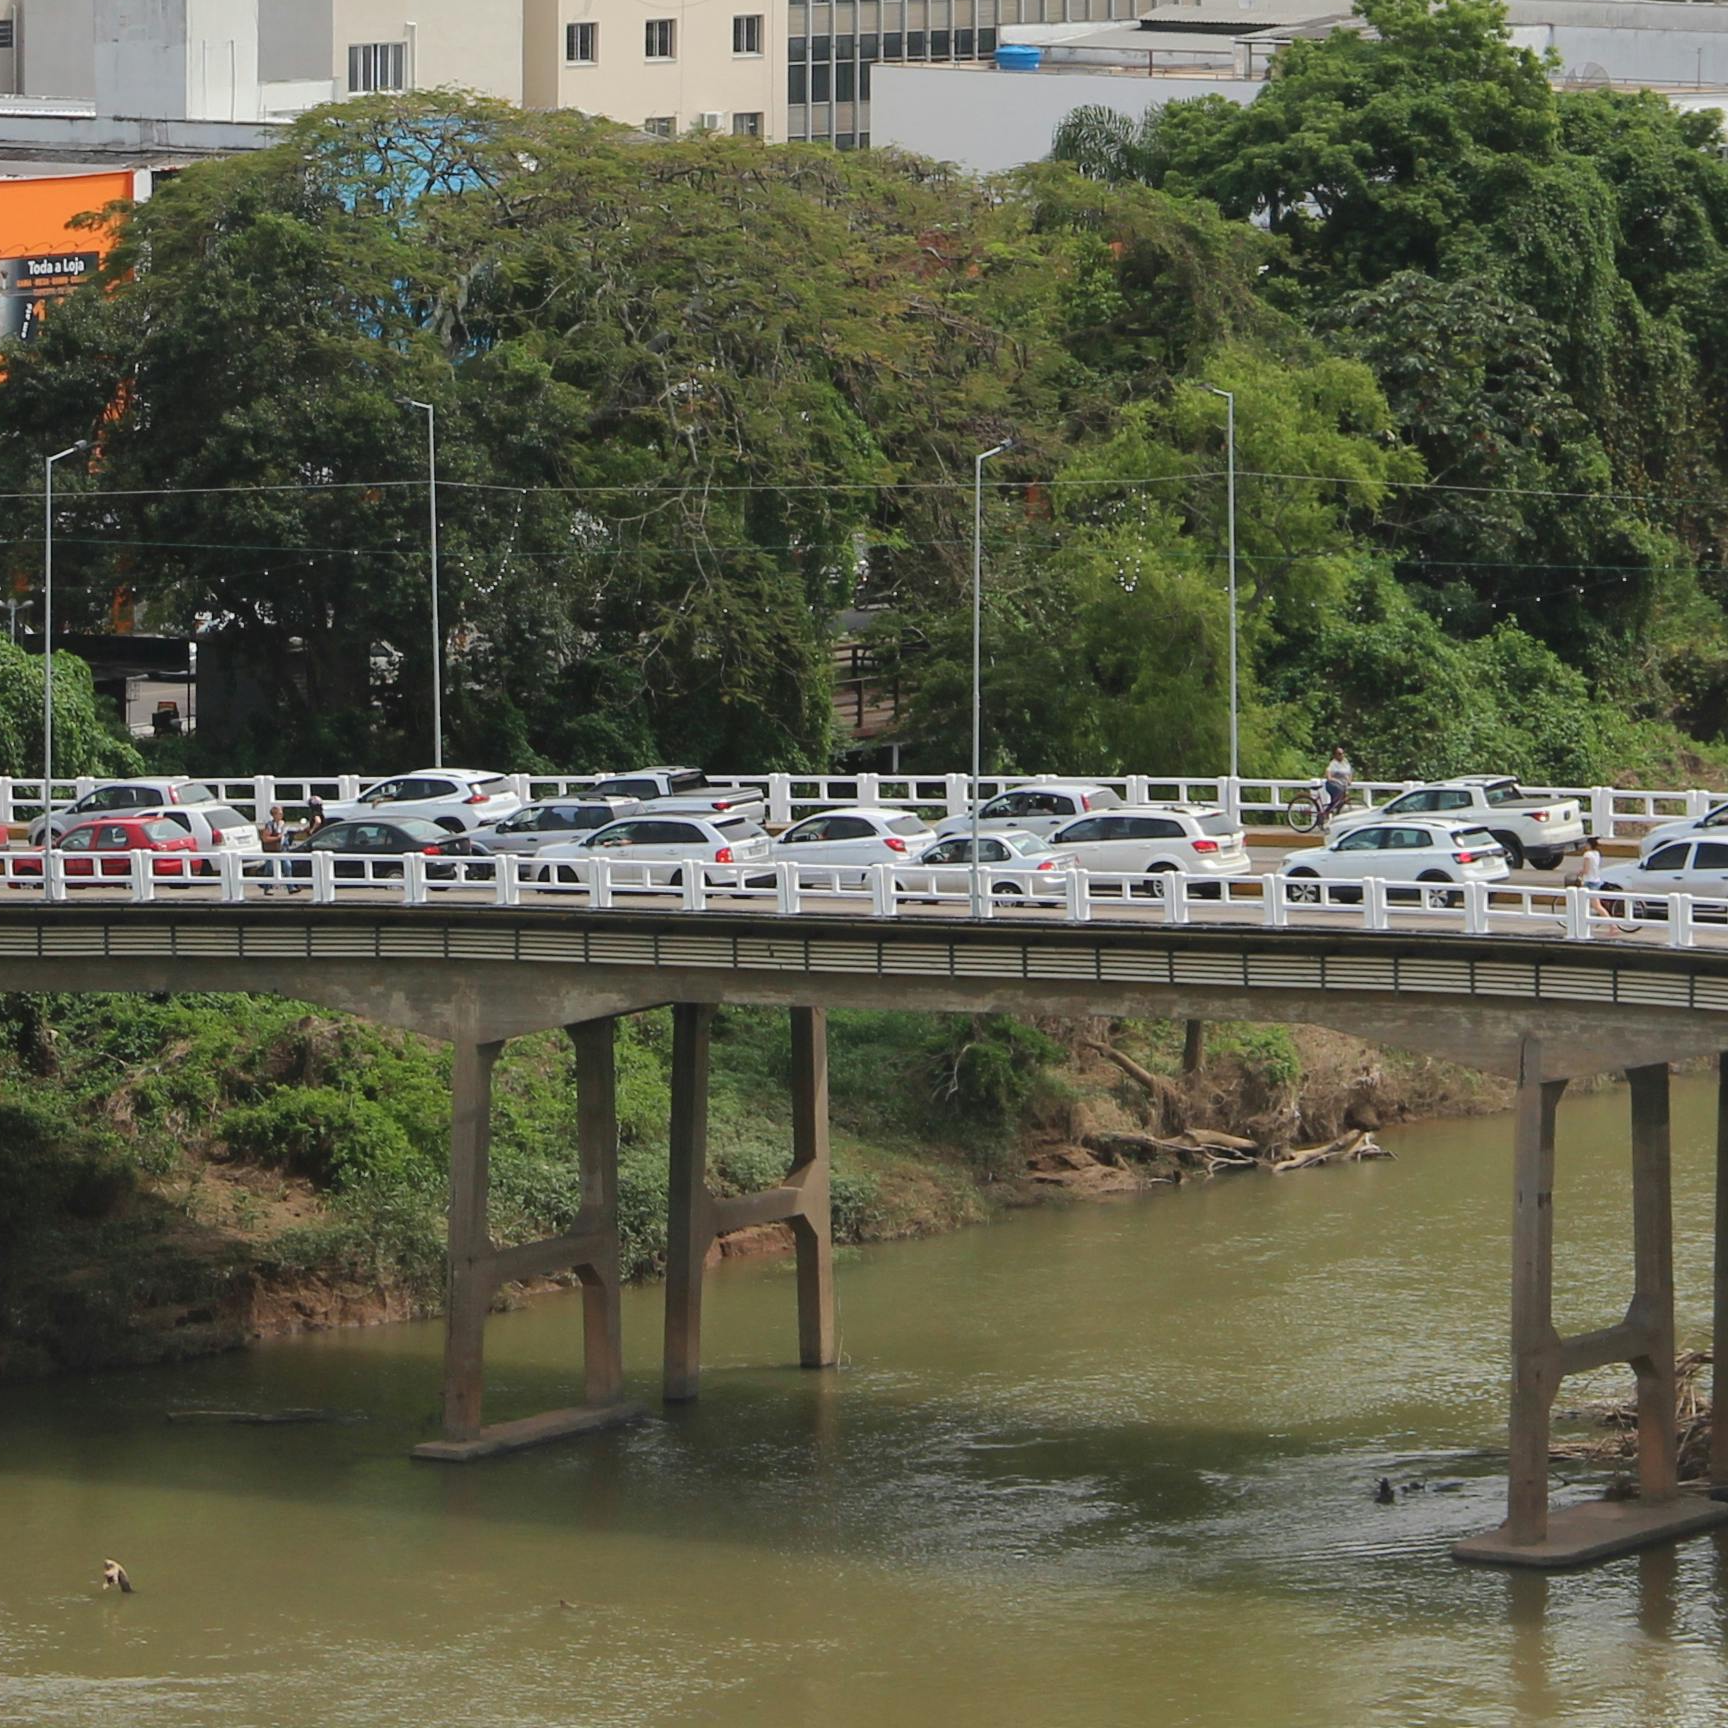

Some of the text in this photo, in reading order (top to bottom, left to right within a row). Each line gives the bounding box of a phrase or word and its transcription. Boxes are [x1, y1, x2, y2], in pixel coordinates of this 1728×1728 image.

[28, 257, 85, 276] Toda a Loja
